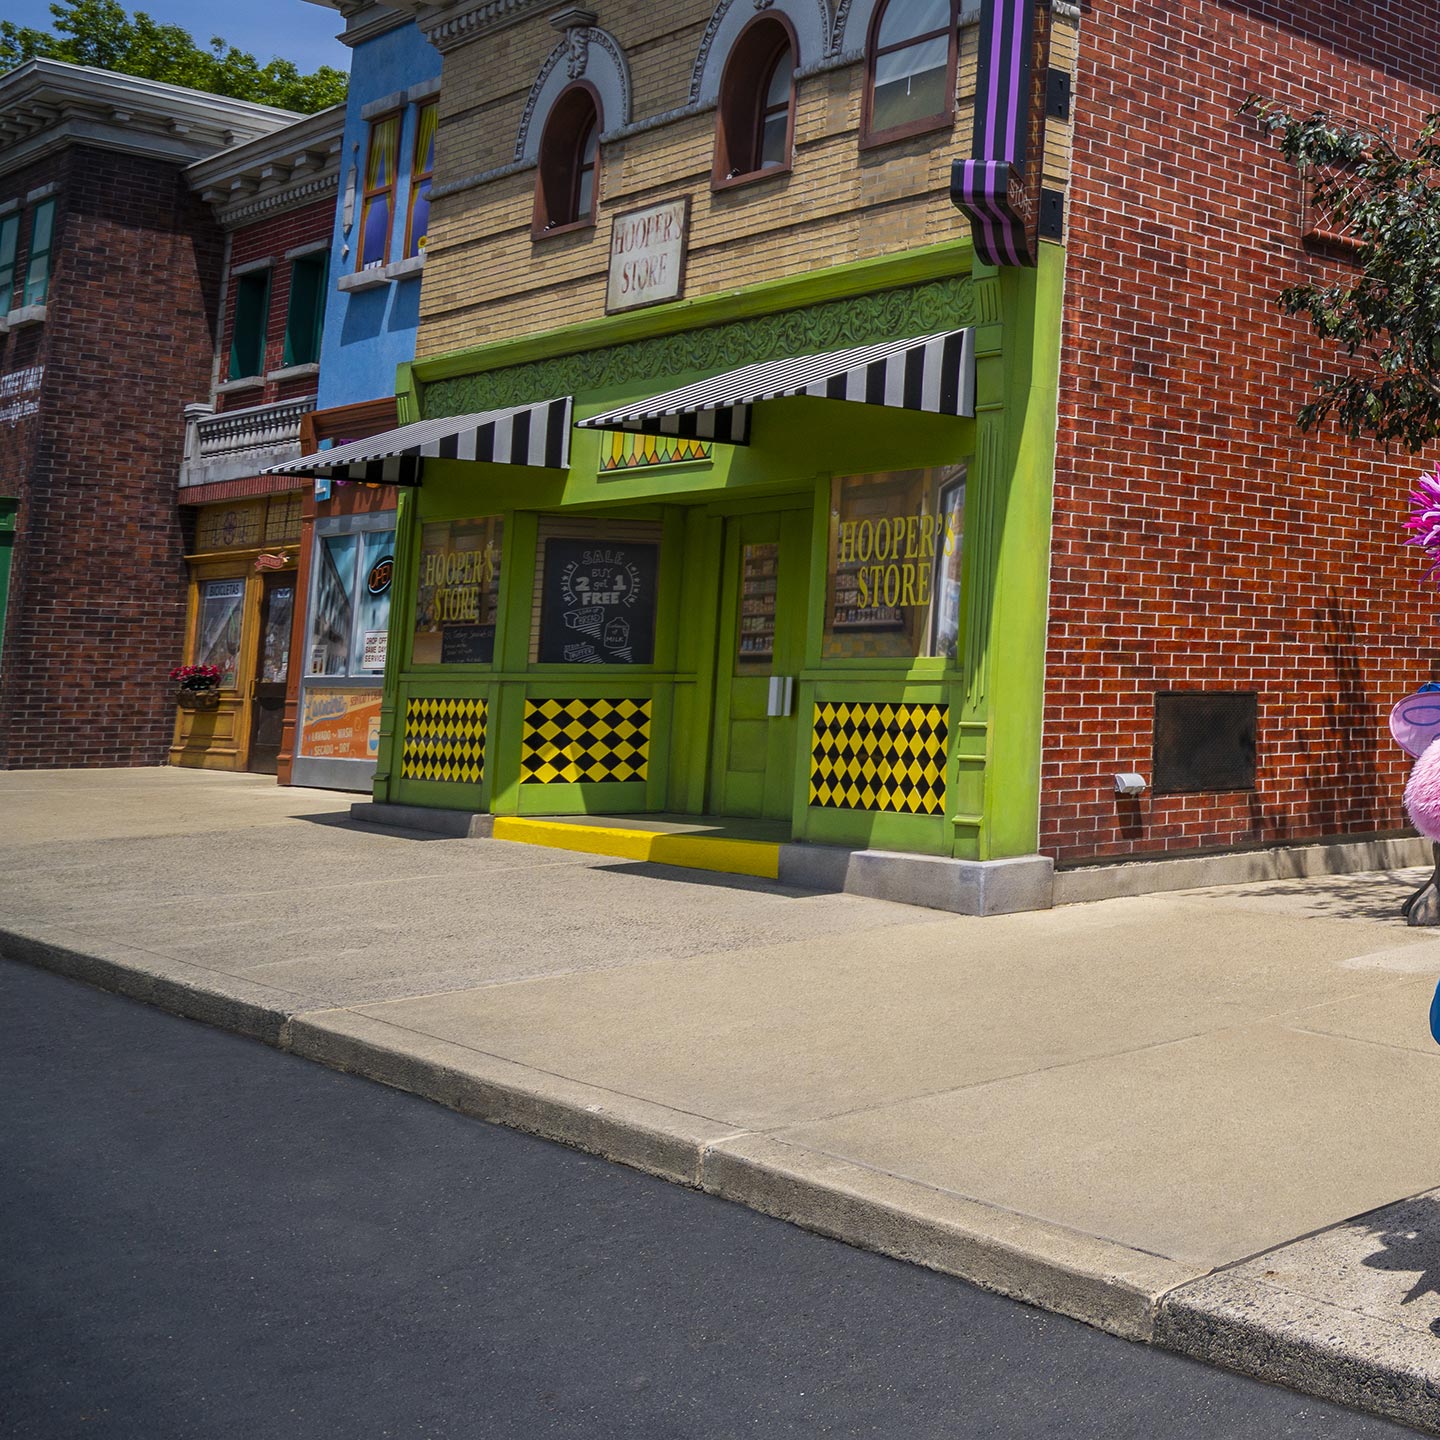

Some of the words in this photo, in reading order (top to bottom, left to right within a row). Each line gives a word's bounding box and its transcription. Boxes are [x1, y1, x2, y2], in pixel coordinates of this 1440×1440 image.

[1008, 178, 1033, 221] STORE
[613, 206, 684, 255] HOOPER'S
[621, 253, 668, 294] STORE
[840, 512, 956, 562] HOOPER'S
[425, 547, 494, 586] HOOPER'S
[582, 550, 625, 565] SALE
[591, 568, 613, 578] BUY
[575, 576, 591, 592] 2
[593, 579, 609, 591] get
[613, 575, 627, 591] 1
[582, 592, 621, 606] FREE
[856, 562, 932, 609] STORE
[433, 587, 480, 621] STORE
[366, 637, 378, 645] DROP
